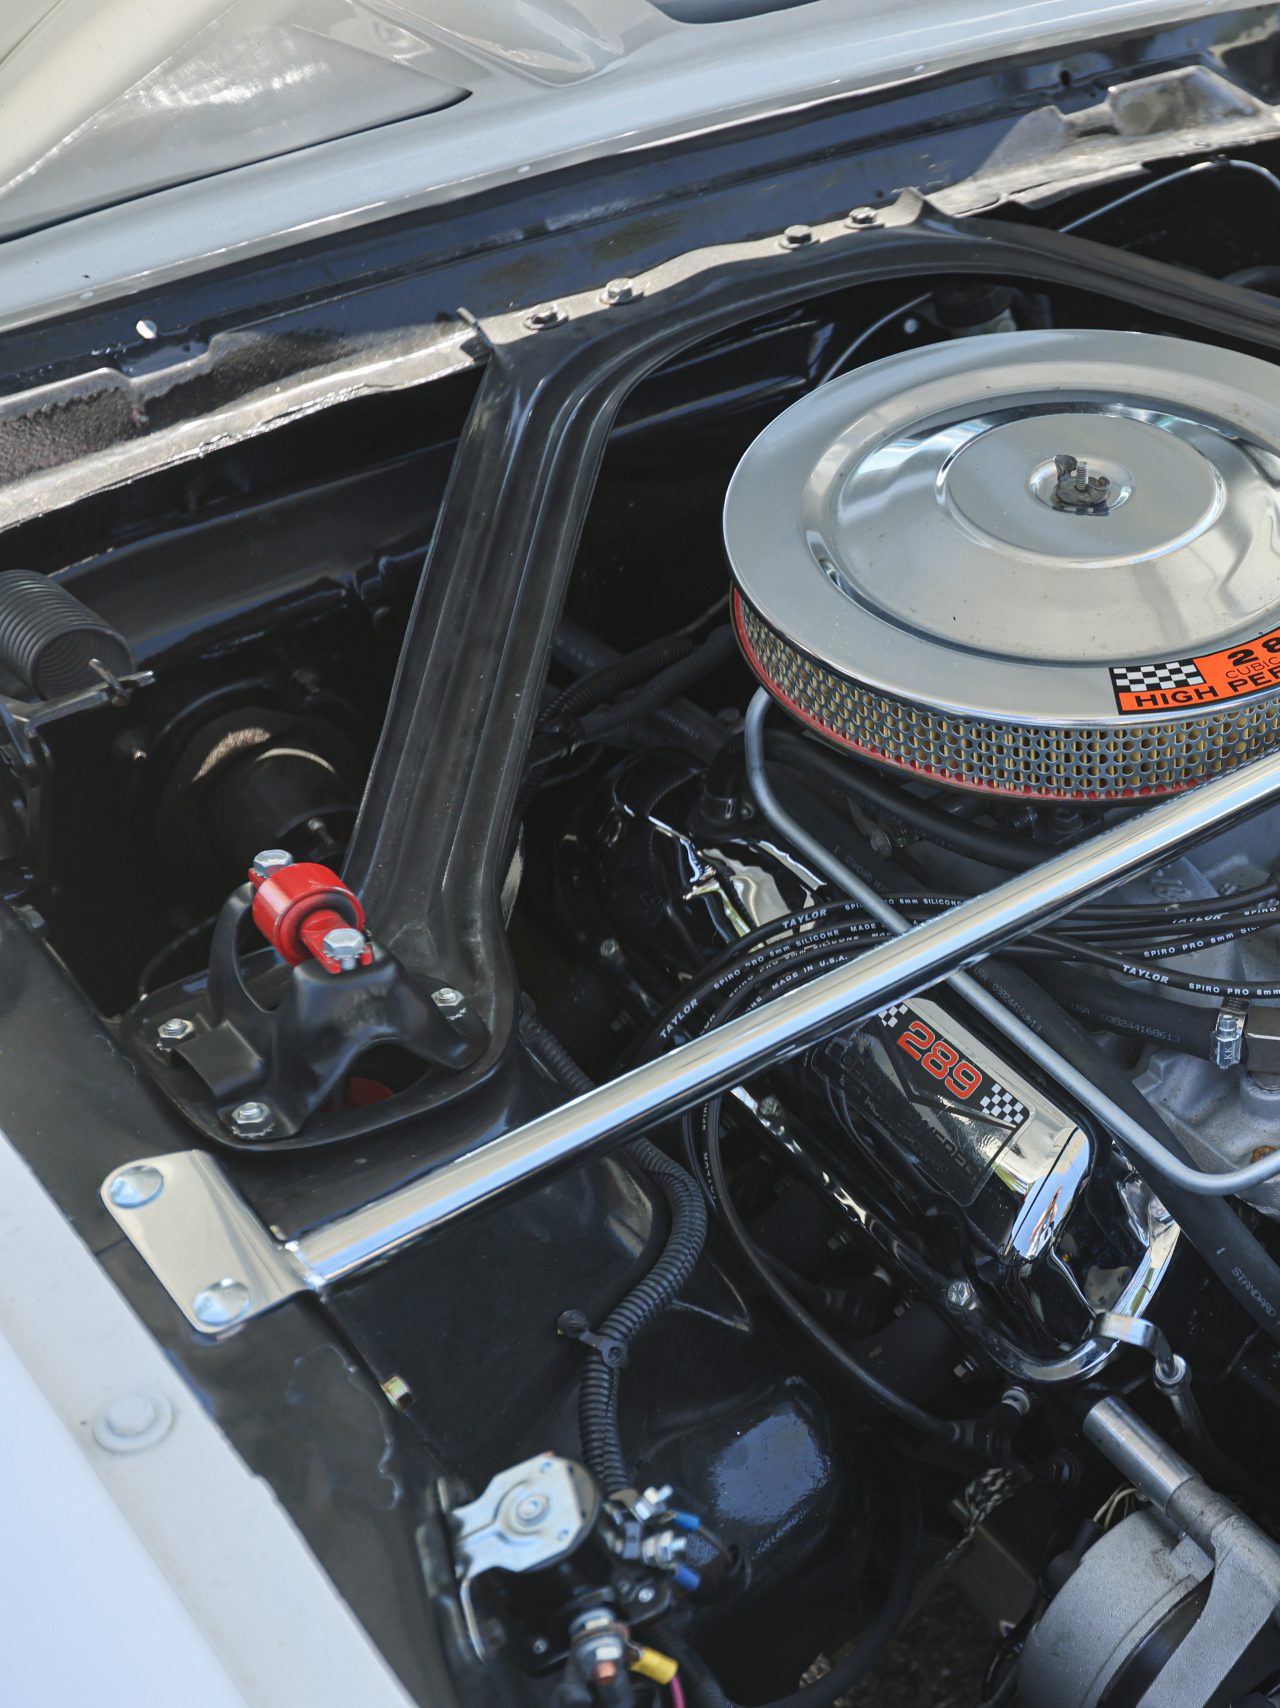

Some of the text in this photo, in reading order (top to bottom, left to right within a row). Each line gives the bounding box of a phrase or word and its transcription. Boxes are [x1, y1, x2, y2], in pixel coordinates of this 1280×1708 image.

[1134, 685, 1220, 708] HIGH
[782, 908, 828, 929] TAYLOR
[1143, 932, 1235, 958] SPIRO PRO 8mm
[660, 998, 698, 1039] TAYLOR
[713, 969, 741, 990] SPIRO
[795, 928, 840, 947] SILICONE
[850, 922, 877, 933] MADE
[771, 955, 848, 991] MADE IN U.S.A.
[1121, 964, 1169, 985] TAYLOR
[1188, 982, 1220, 994] SPIRO
[1227, 987, 1250, 996] PRO
[1256, 988, 1280, 996] 8mm
[896, 1020, 983, 1100] 289
